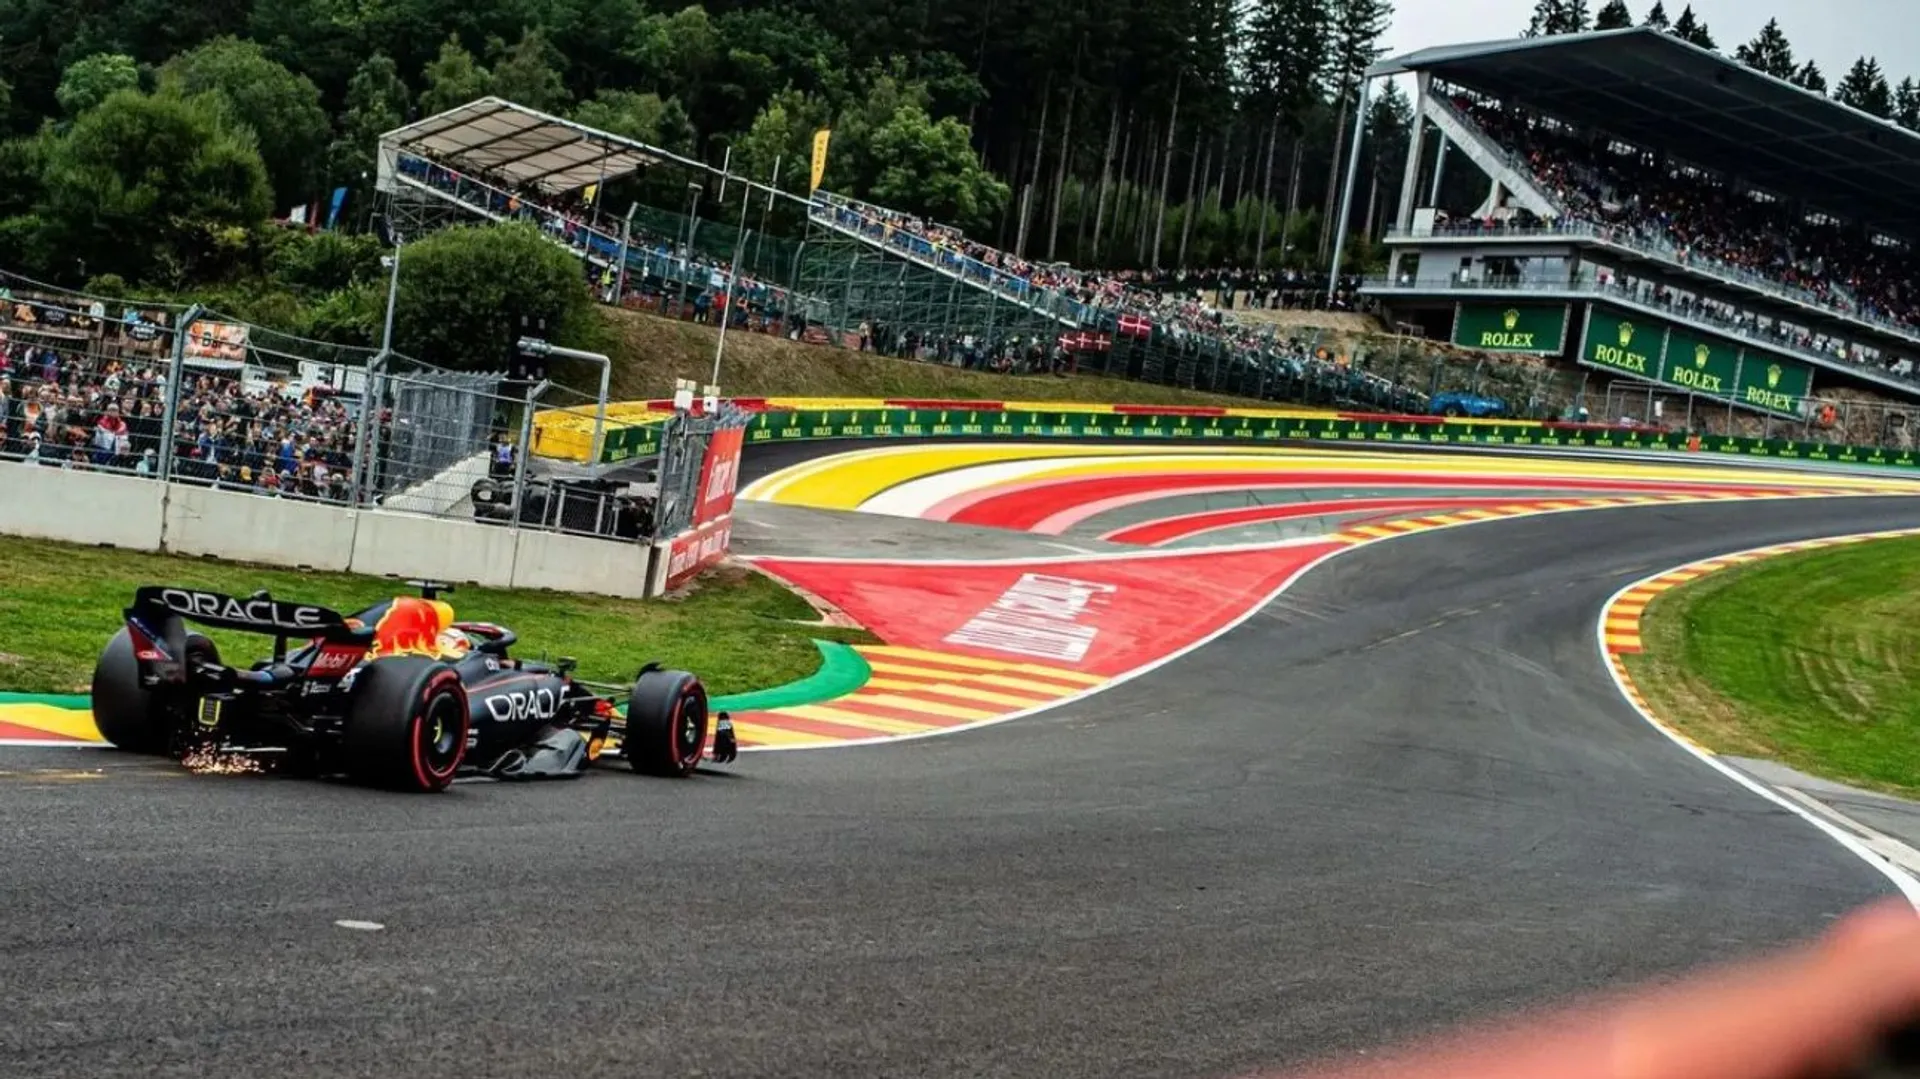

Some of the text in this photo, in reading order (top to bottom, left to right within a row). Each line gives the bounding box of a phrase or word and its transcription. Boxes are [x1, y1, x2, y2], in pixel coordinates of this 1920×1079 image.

[1481, 332, 1534, 347] ROLEX
[1595, 344, 1647, 372] ROLEX
[1672, 367, 1721, 393] ROLEX
[1746, 386, 1792, 411] ROLEX
[162, 589, 321, 628] ORACLE
